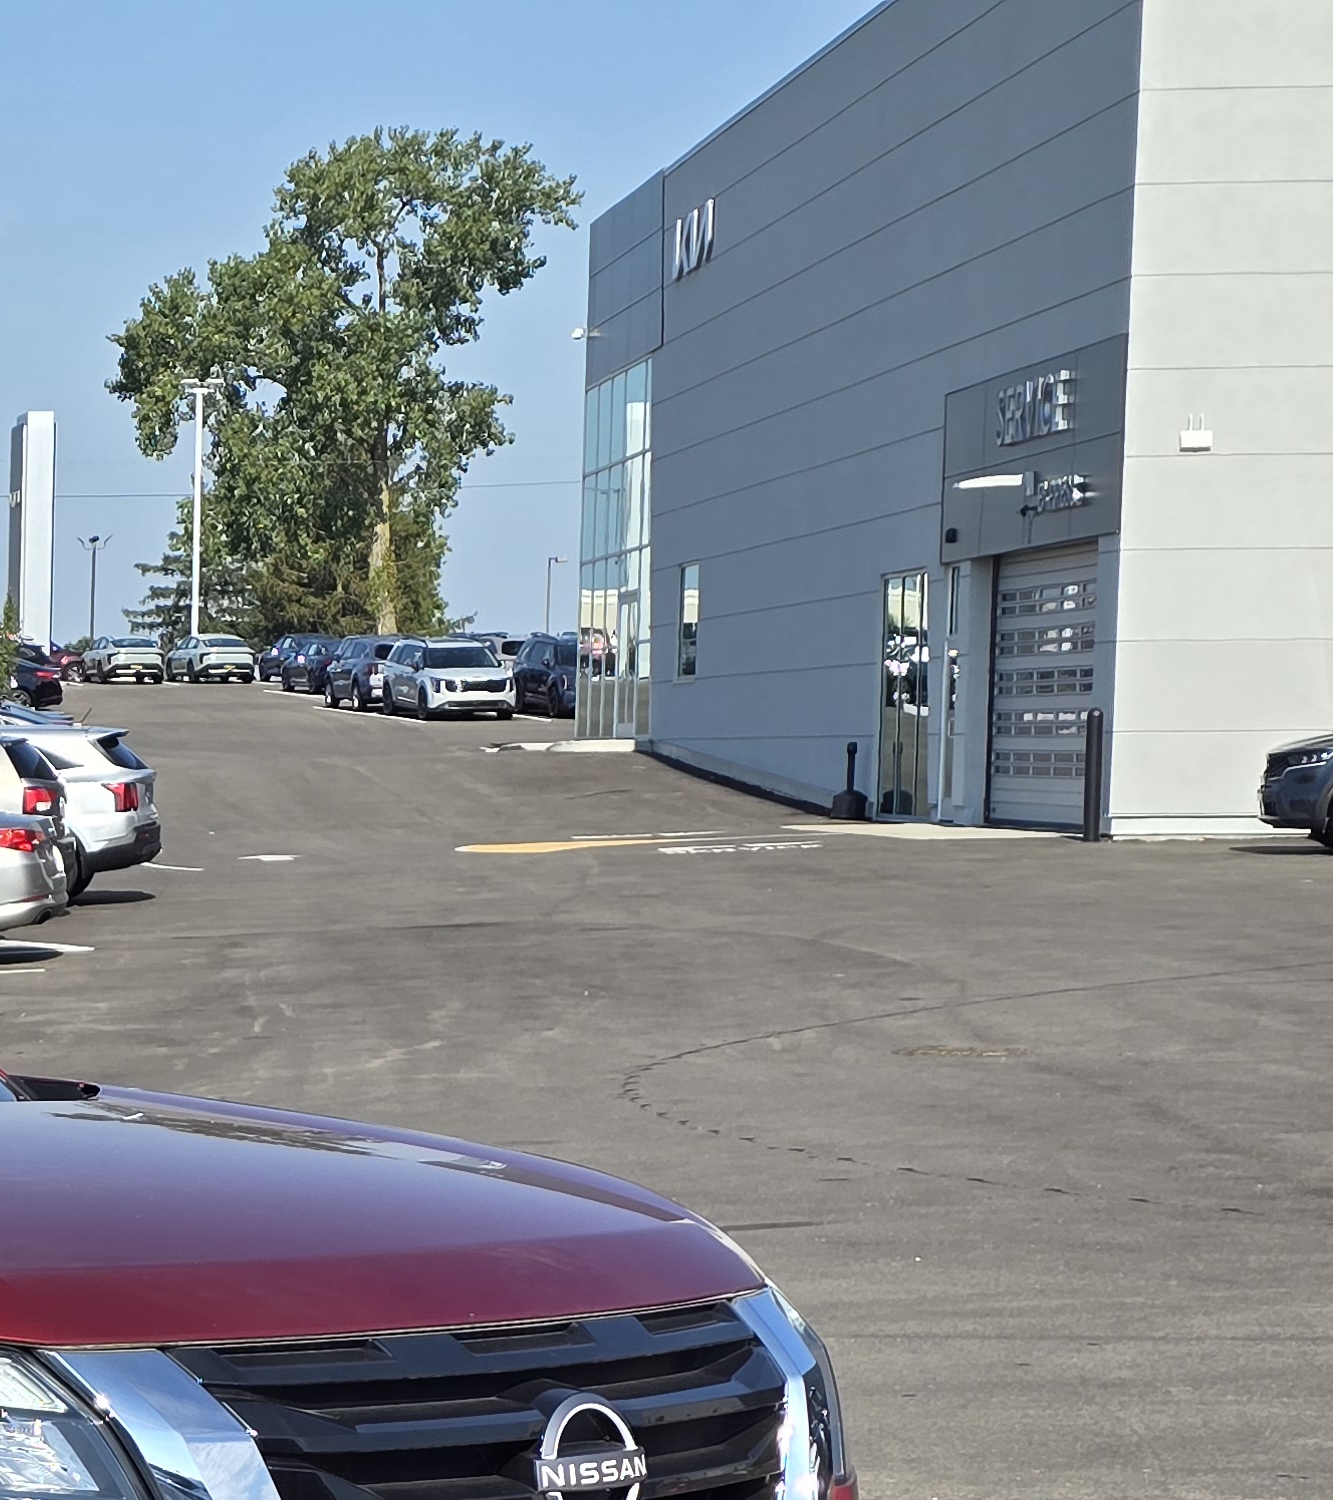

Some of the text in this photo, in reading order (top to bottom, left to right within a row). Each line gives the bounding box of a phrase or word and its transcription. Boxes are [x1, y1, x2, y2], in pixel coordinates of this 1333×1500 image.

[671, 198, 715, 280] KIA
[995, 369, 1080, 448] SERVICE
[541, 1453, 648, 1488] NISSAN
